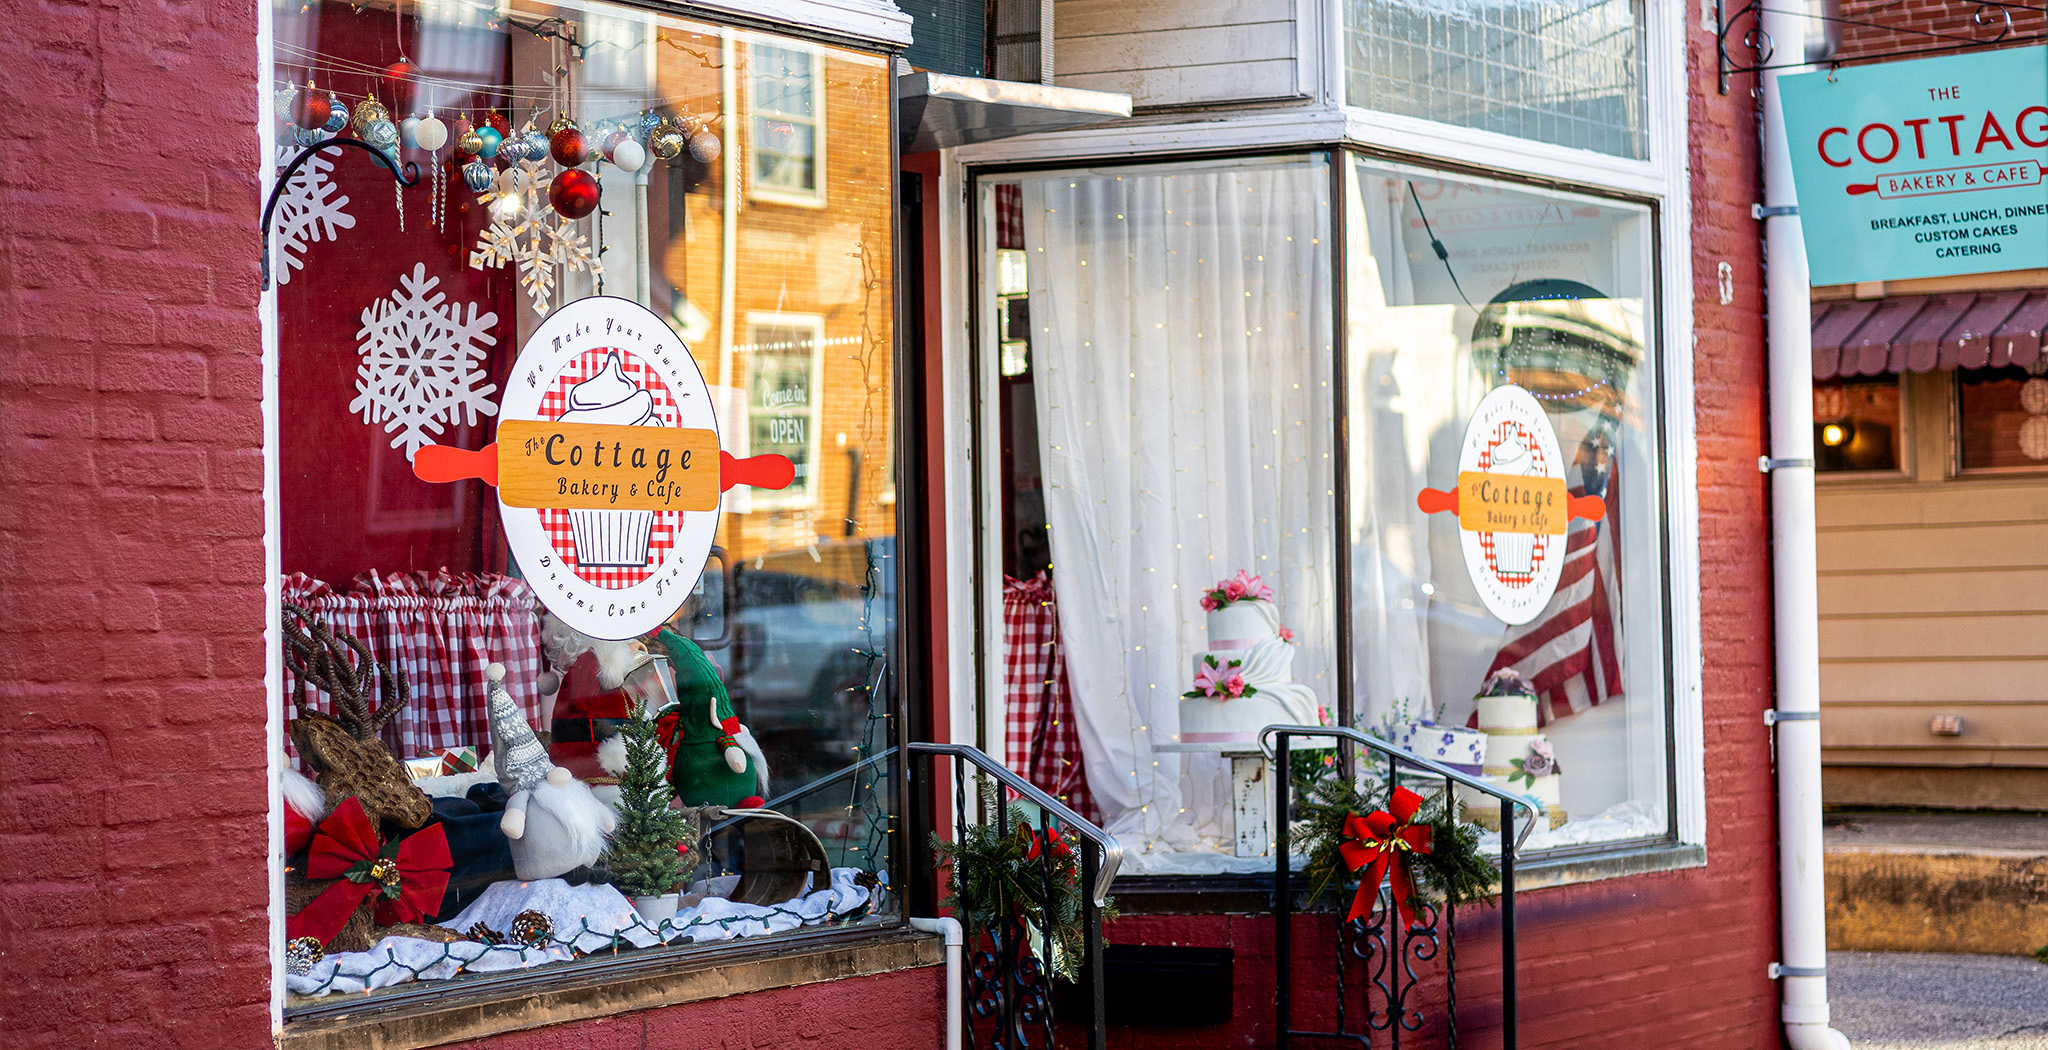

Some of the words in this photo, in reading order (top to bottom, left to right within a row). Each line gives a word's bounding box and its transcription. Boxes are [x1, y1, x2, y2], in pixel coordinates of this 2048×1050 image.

[1927, 85, 1961, 102] THE
[1889, 173, 1956, 193] BAKERY
[1964, 171, 1976, 185] &
[1983, 166, 2029, 184] CAFE
[1870, 213, 1950, 230] BREAKFAST,
[1953, 209, 2002, 224] LUNCH,
[1914, 228, 1970, 243] CUSTOM
[1972, 224, 2018, 239] CAKES
[1935, 243, 2002, 258] CATERING
[526, 363, 545, 391] We
[552, 324, 591, 354] Make
[605, 316, 644, 343] Your
[653, 342, 691, 400] Sweet
[762, 385, 794, 410] Come
[794, 384, 807, 403] in
[769, 418, 805, 444] OPEN
[525, 437, 545, 457] The
[545, 433, 693, 484] Cottage
[557, 477, 620, 504] Bakery
[629, 484, 639, 497] &
[646, 479, 683, 505] Cafe
[1481, 480, 1553, 515] Cottage
[1487, 510, 1517, 529] Bakery
[1529, 512, 1549, 531] Cafe
[539, 555, 595, 614] Dreams
[607, 600, 647, 618] Come
[655, 556, 686, 598] True
